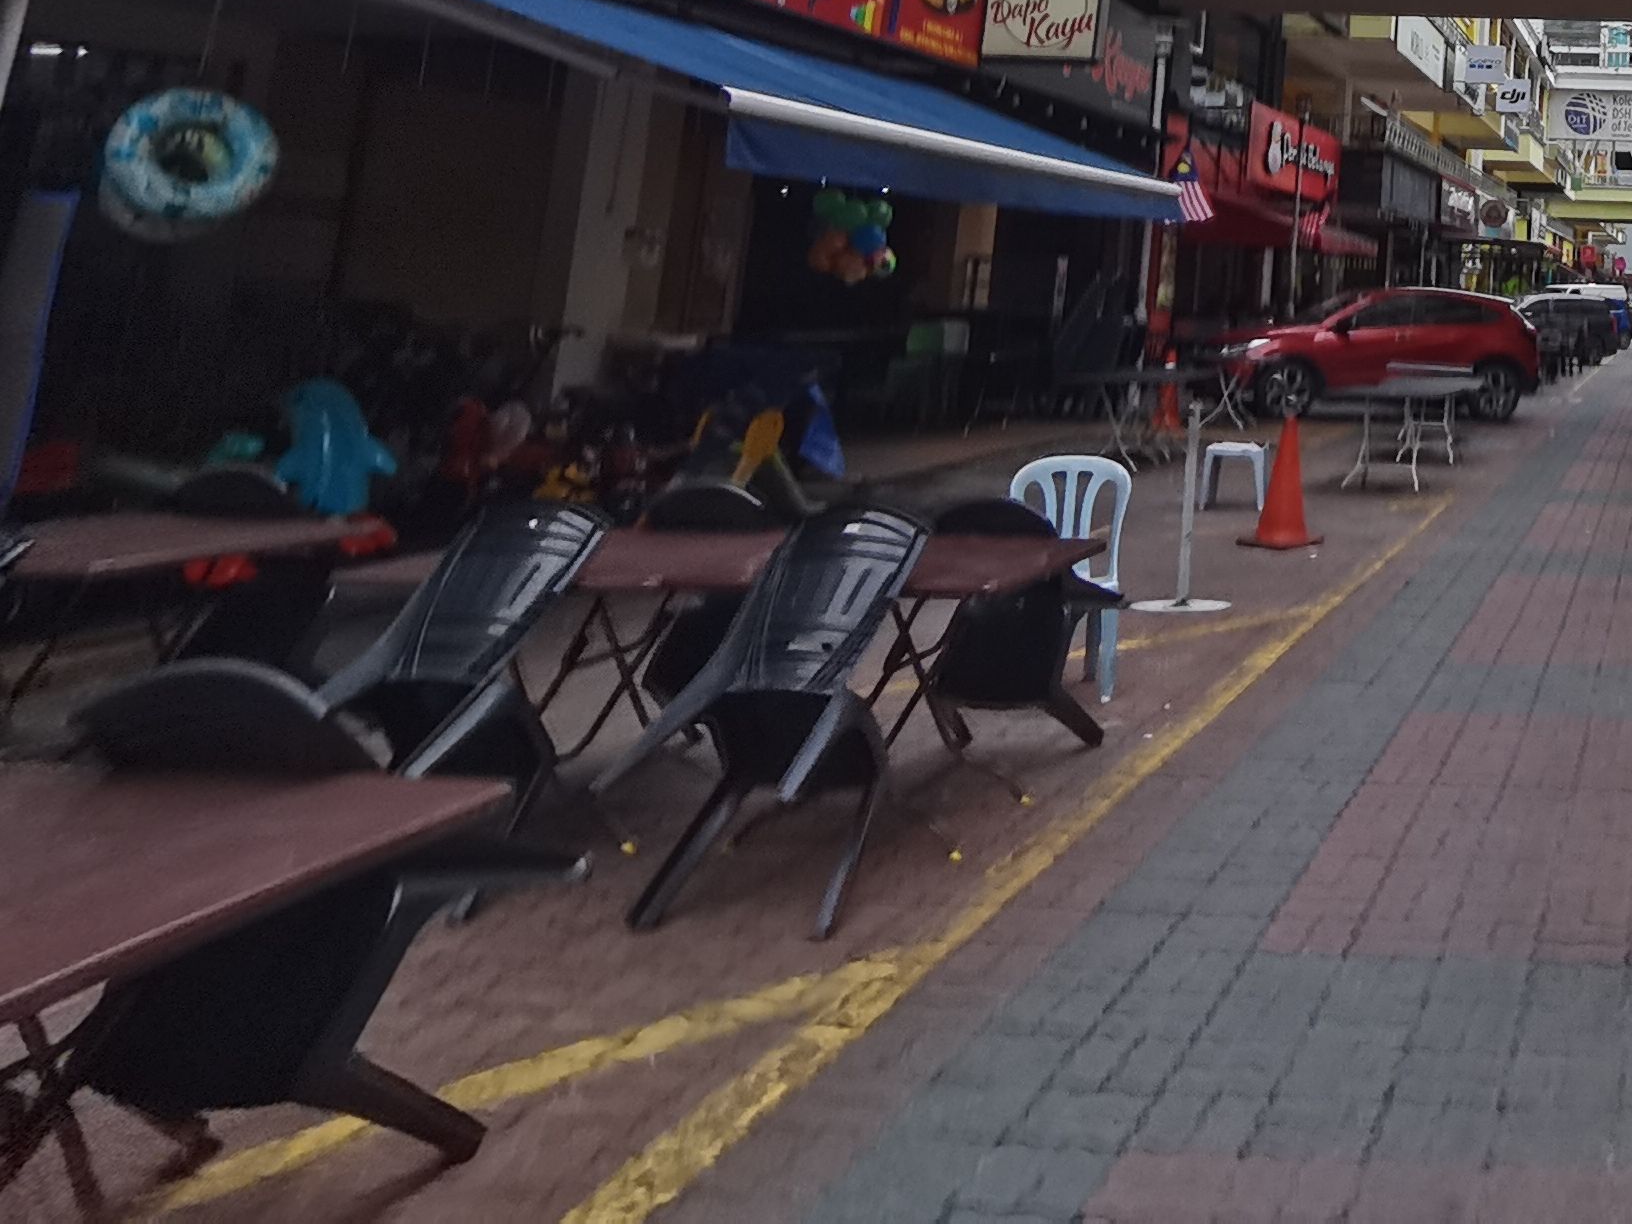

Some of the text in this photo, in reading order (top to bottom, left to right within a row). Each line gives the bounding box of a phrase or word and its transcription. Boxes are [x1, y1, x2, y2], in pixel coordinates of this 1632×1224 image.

[1025, 12, 1094, 50] Kayu
[1611, 107, 1632, 120] DSH
[1611, 120, 1622, 133] of
